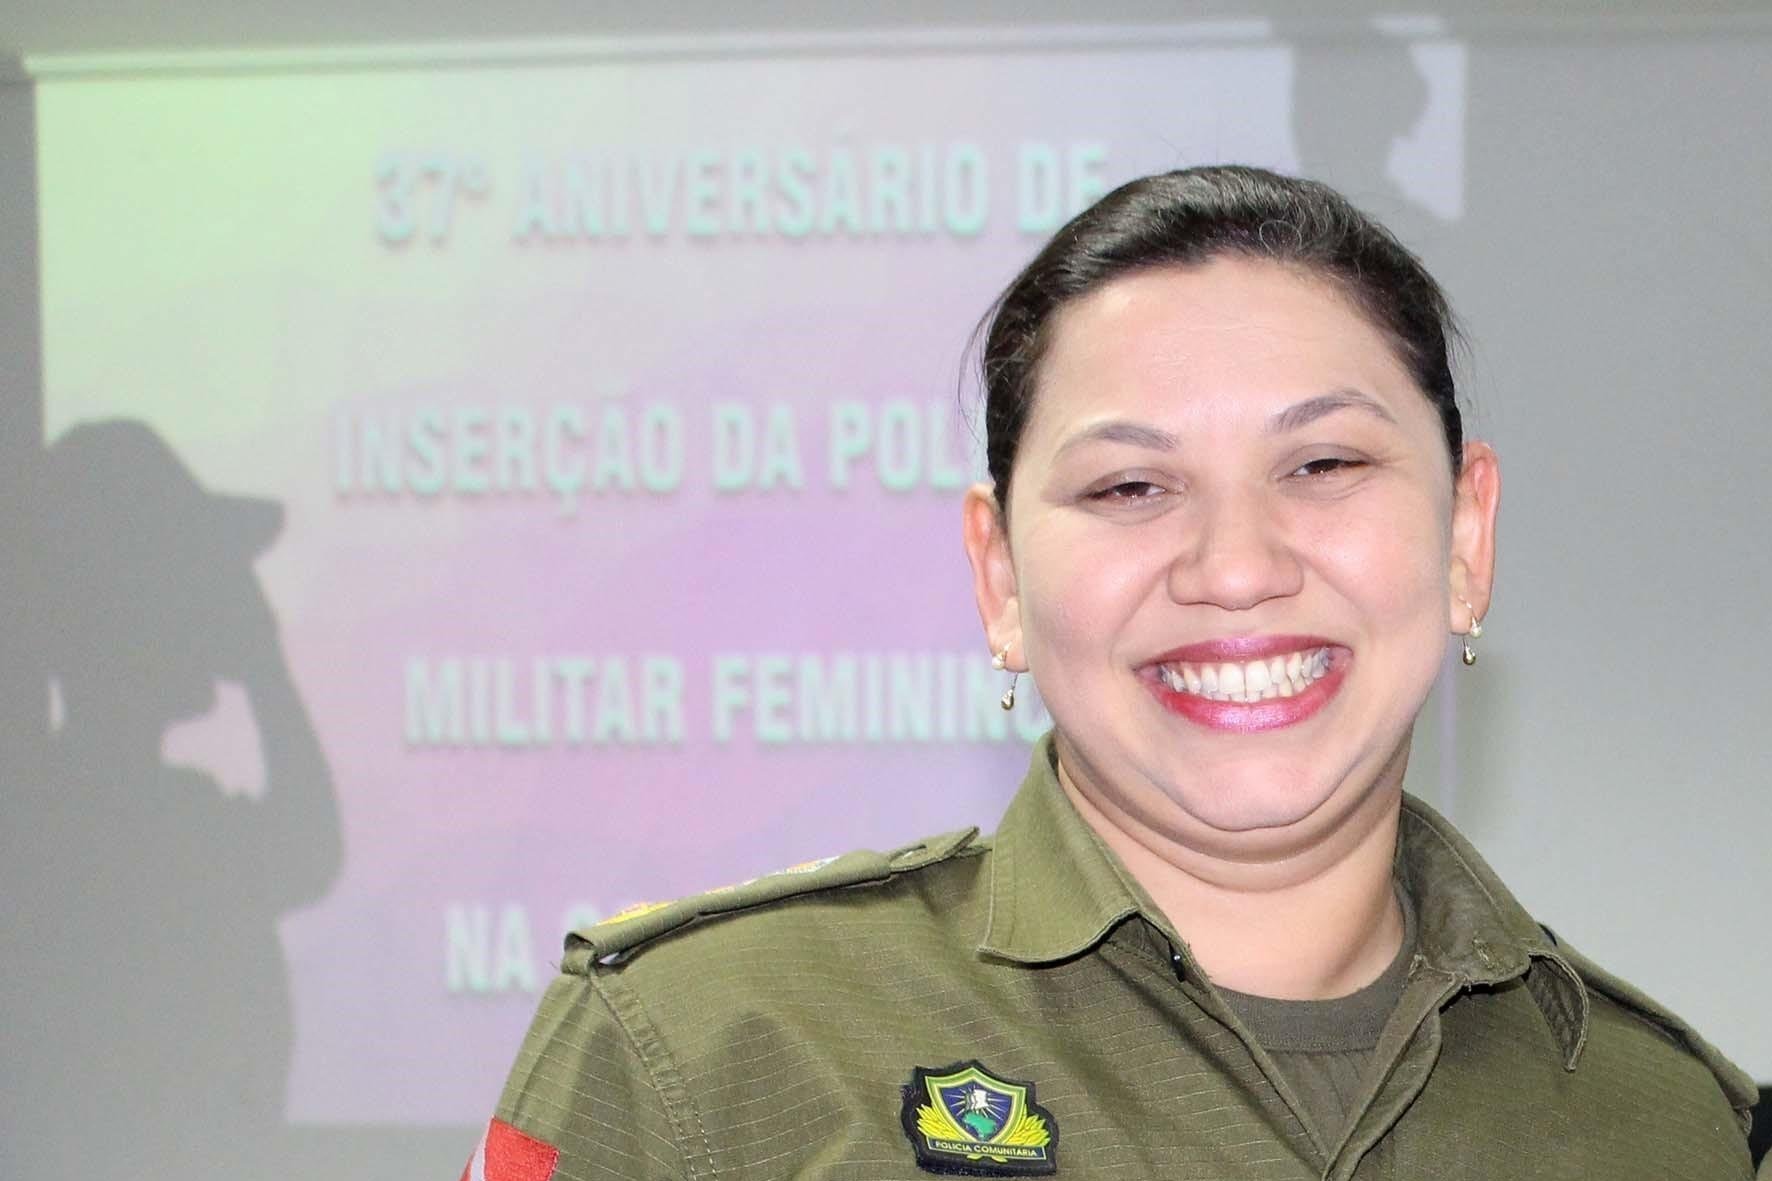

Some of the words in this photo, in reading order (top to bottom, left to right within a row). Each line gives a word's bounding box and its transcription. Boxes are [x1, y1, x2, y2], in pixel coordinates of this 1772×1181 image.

[511, 126, 990, 242] ANIVERSÁRIO
[333, 383, 685, 517] INSERÇÃO
[710, 402, 806, 492] DA
[404, 655, 690, 746] MILITAR
[444, 902, 540, 992] NA
